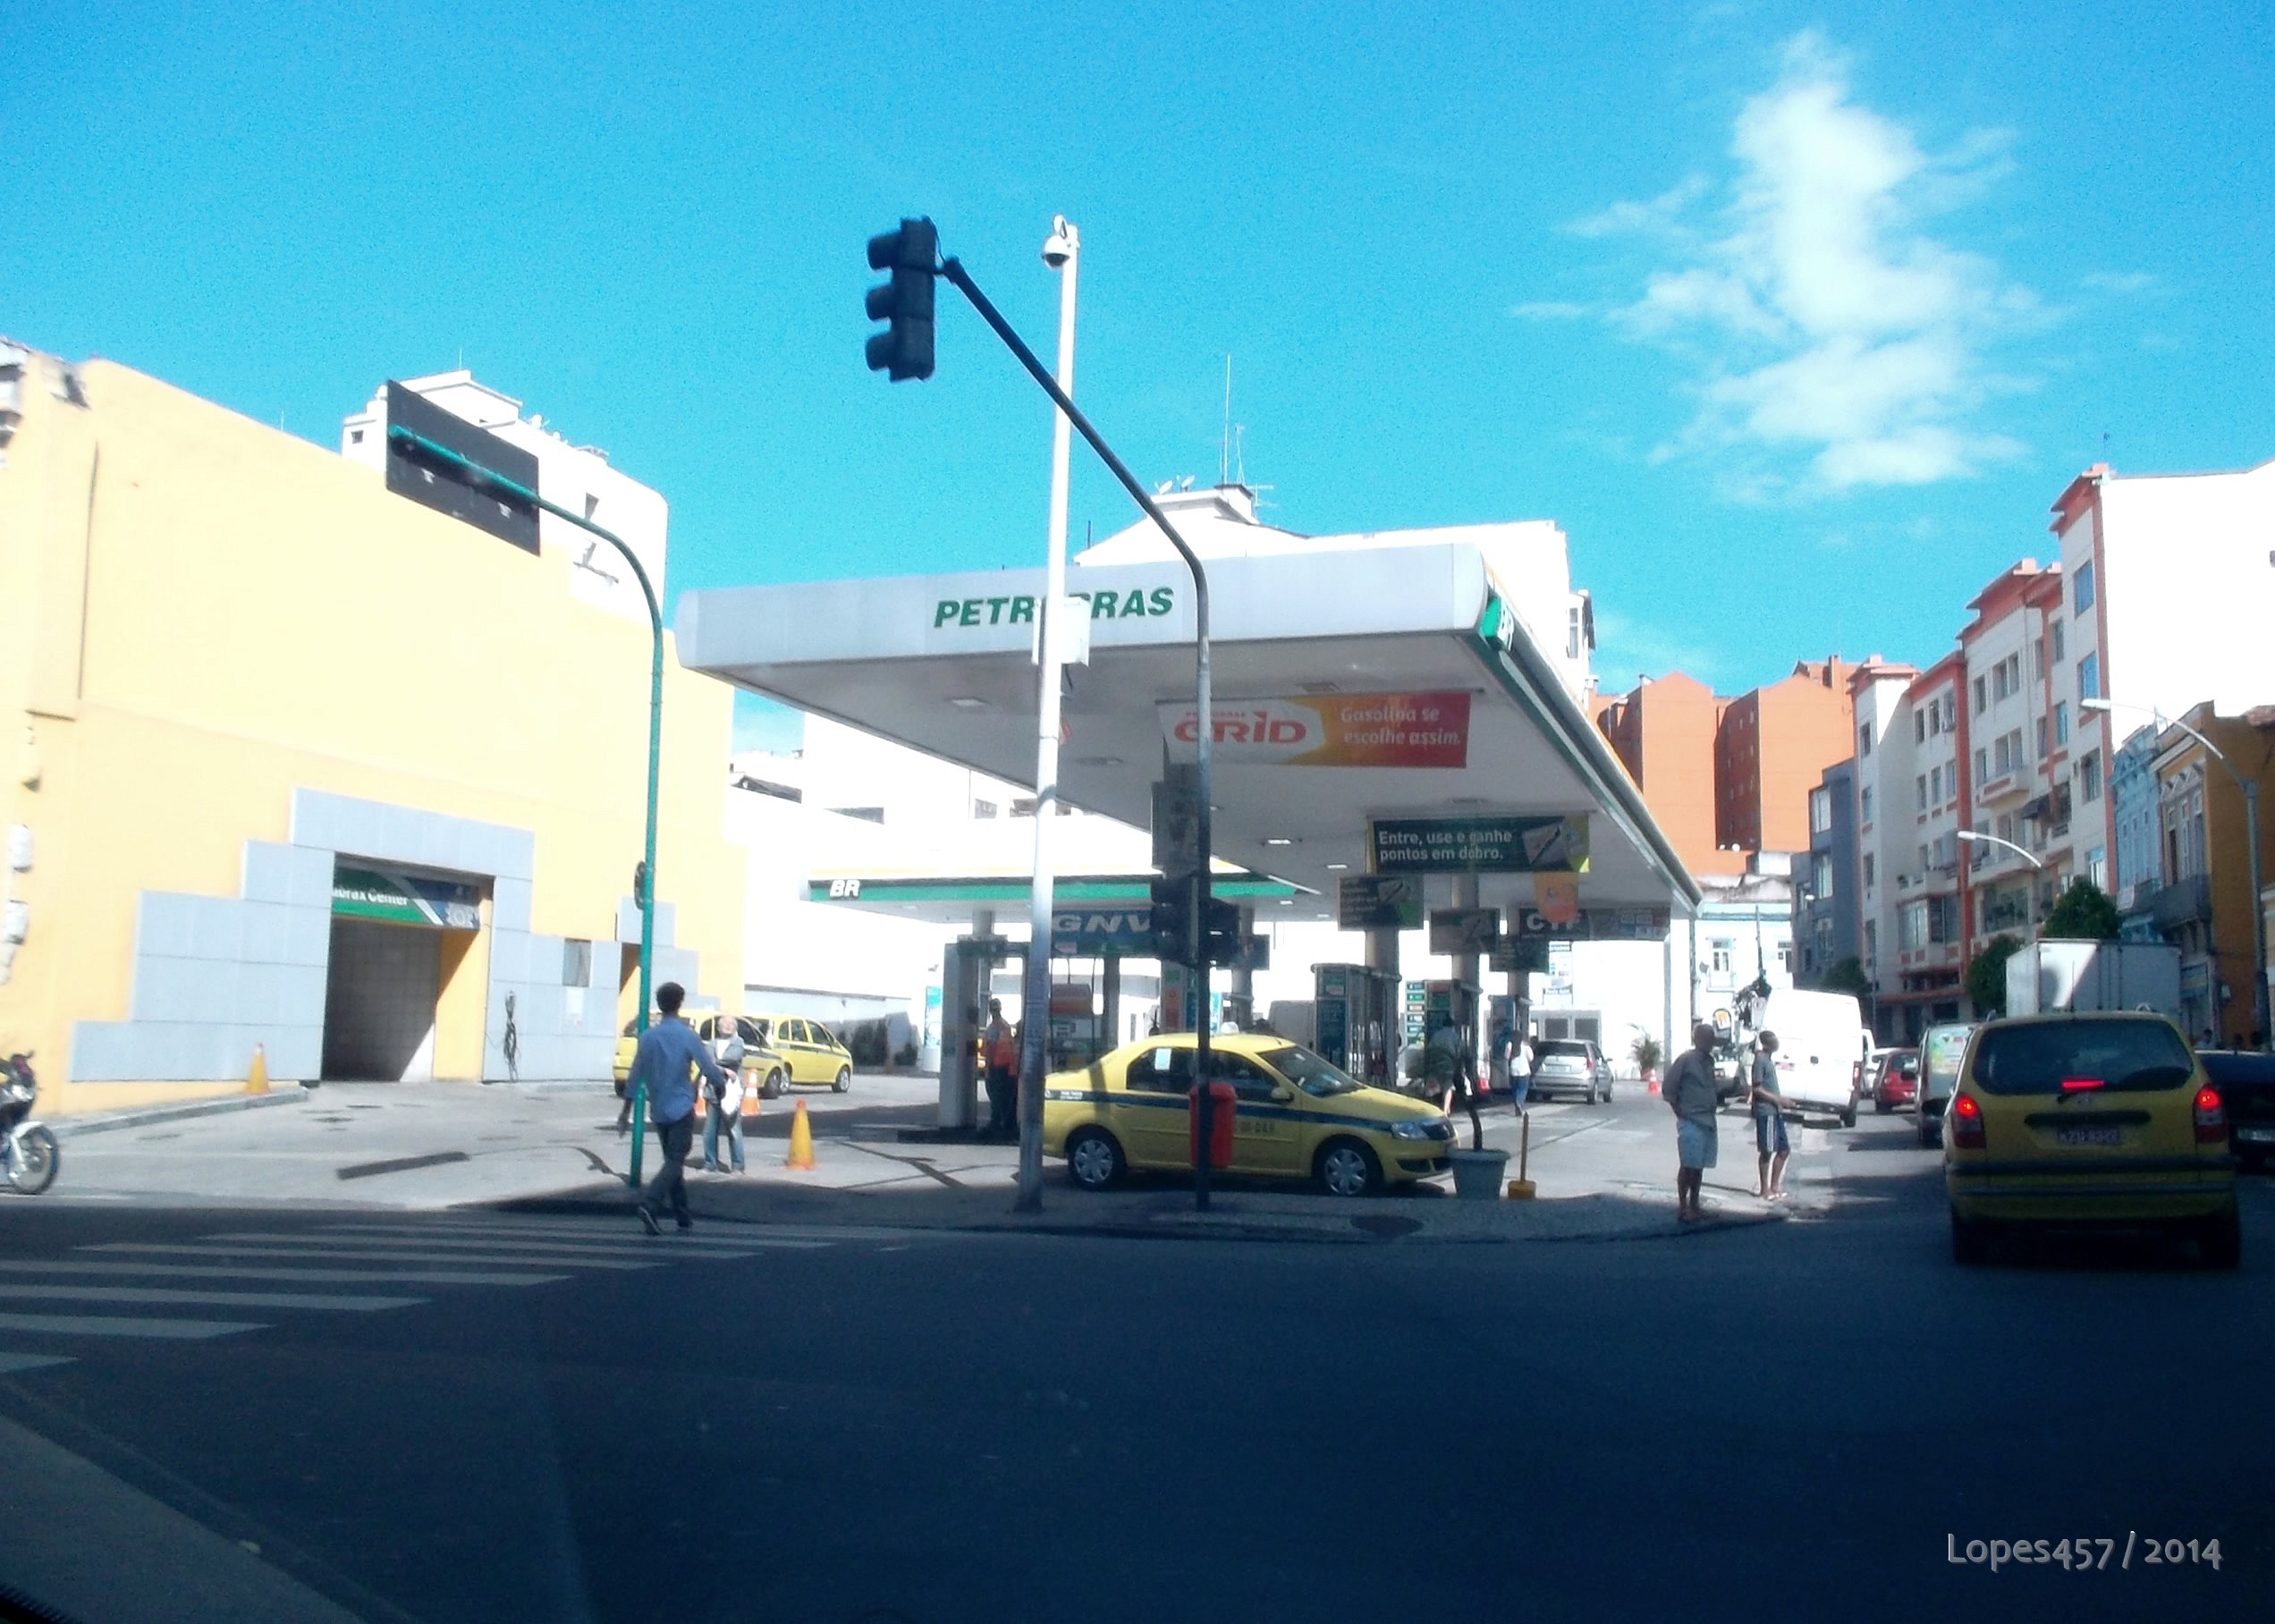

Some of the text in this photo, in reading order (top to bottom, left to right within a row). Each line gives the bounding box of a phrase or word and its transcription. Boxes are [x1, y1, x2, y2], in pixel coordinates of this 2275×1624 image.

[934, 587, 1174, 629] PETRRAS
[1341, 706, 1440, 723] Gasolina se
[1343, 727, 1405, 745] escolhe
[1378, 830, 1512, 848] Entre, use e ganhe
[1380, 845, 1504, 863] pontos em dobro.
[829, 879, 860, 898] BR
[1052, 914, 1152, 933] GNV
